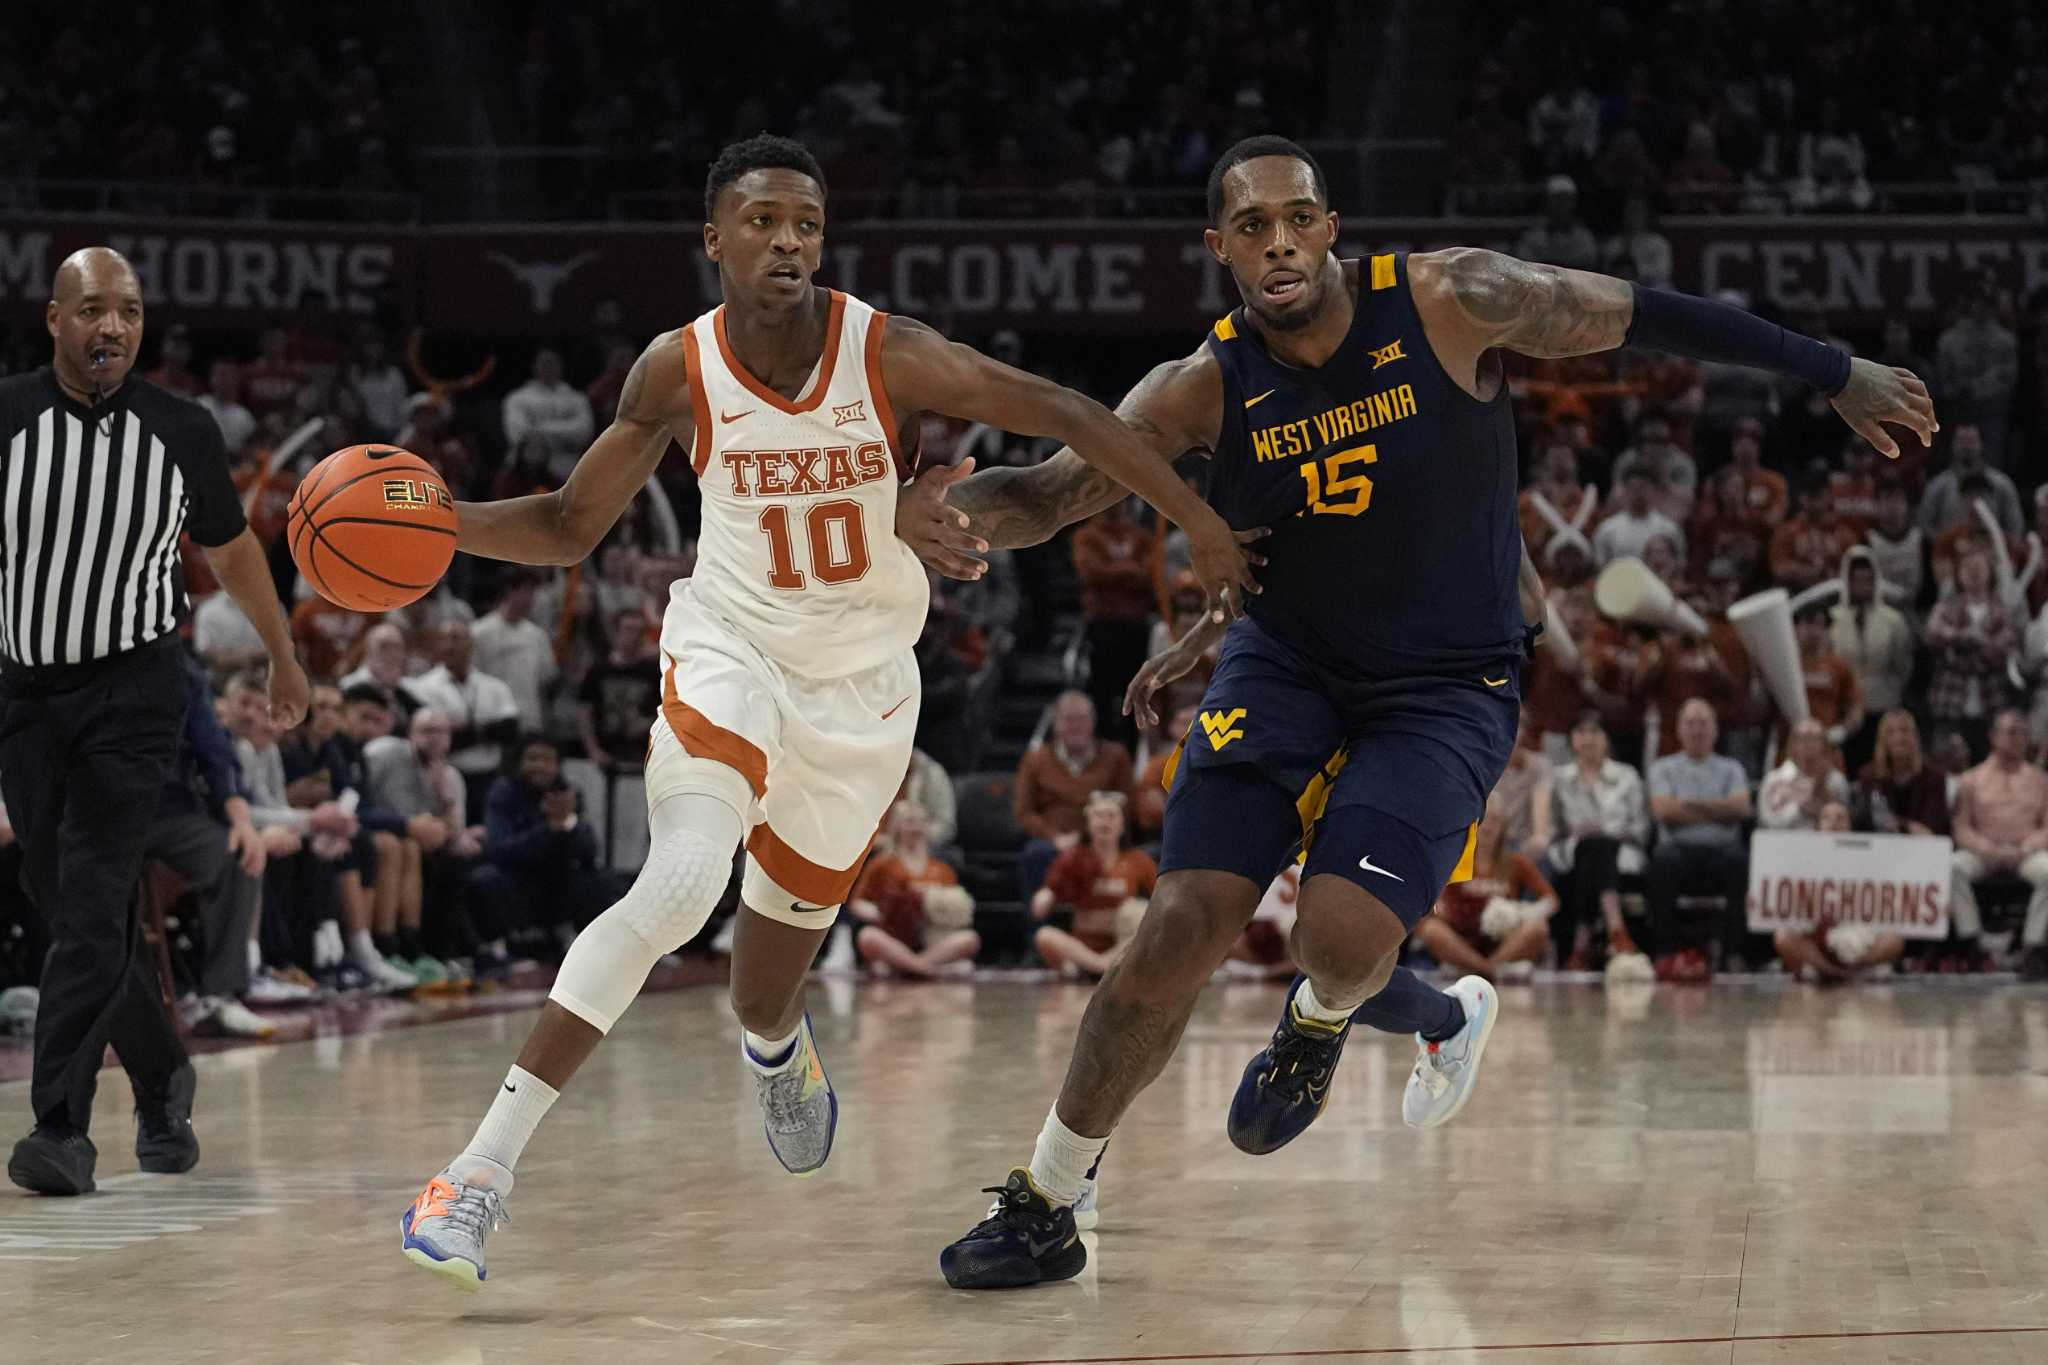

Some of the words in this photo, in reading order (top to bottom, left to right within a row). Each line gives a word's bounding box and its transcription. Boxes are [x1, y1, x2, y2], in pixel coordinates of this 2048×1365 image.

[108, 234, 391, 312] HORNS
[692, 242, 1145, 312] LCOME
[1250, 418, 1314, 464] WEST
[1312, 382, 1419, 447] VIRGINIA
[383, 479, 454, 512] ELITE
[721, 440, 889, 498] TEXAS
[1296, 442, 1379, 518] 15
[758, 498, 872, 591] 10
[1760, 877, 1941, 926] LONGHORNS
